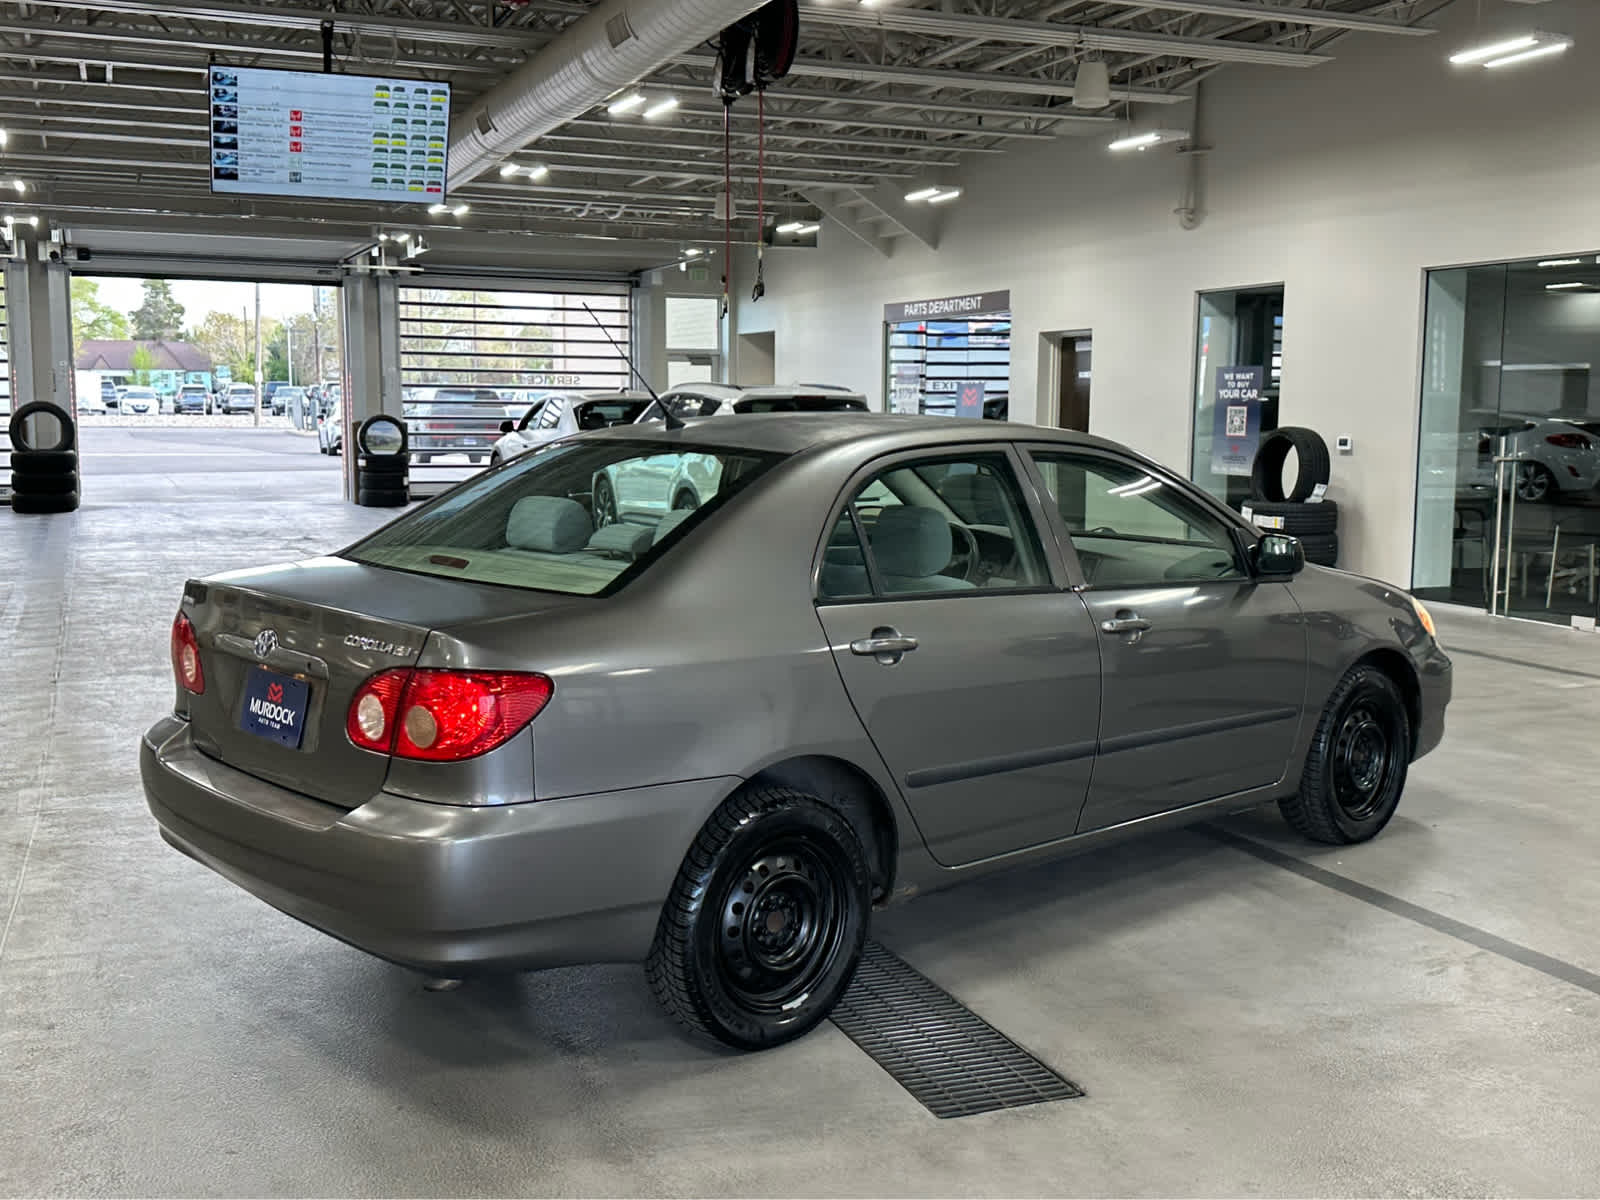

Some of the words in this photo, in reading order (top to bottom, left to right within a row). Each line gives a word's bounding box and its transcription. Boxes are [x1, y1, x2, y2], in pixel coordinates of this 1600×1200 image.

[904, 303, 927, 315] PARTS
[929, 297, 982, 314] DEPARTMENT
[1236, 372, 1254, 380] WANT
[1219, 389, 1240, 399] YOUR
[1241, 389, 1258, 399] CAR
[249, 697, 296, 727] MURDOCK
